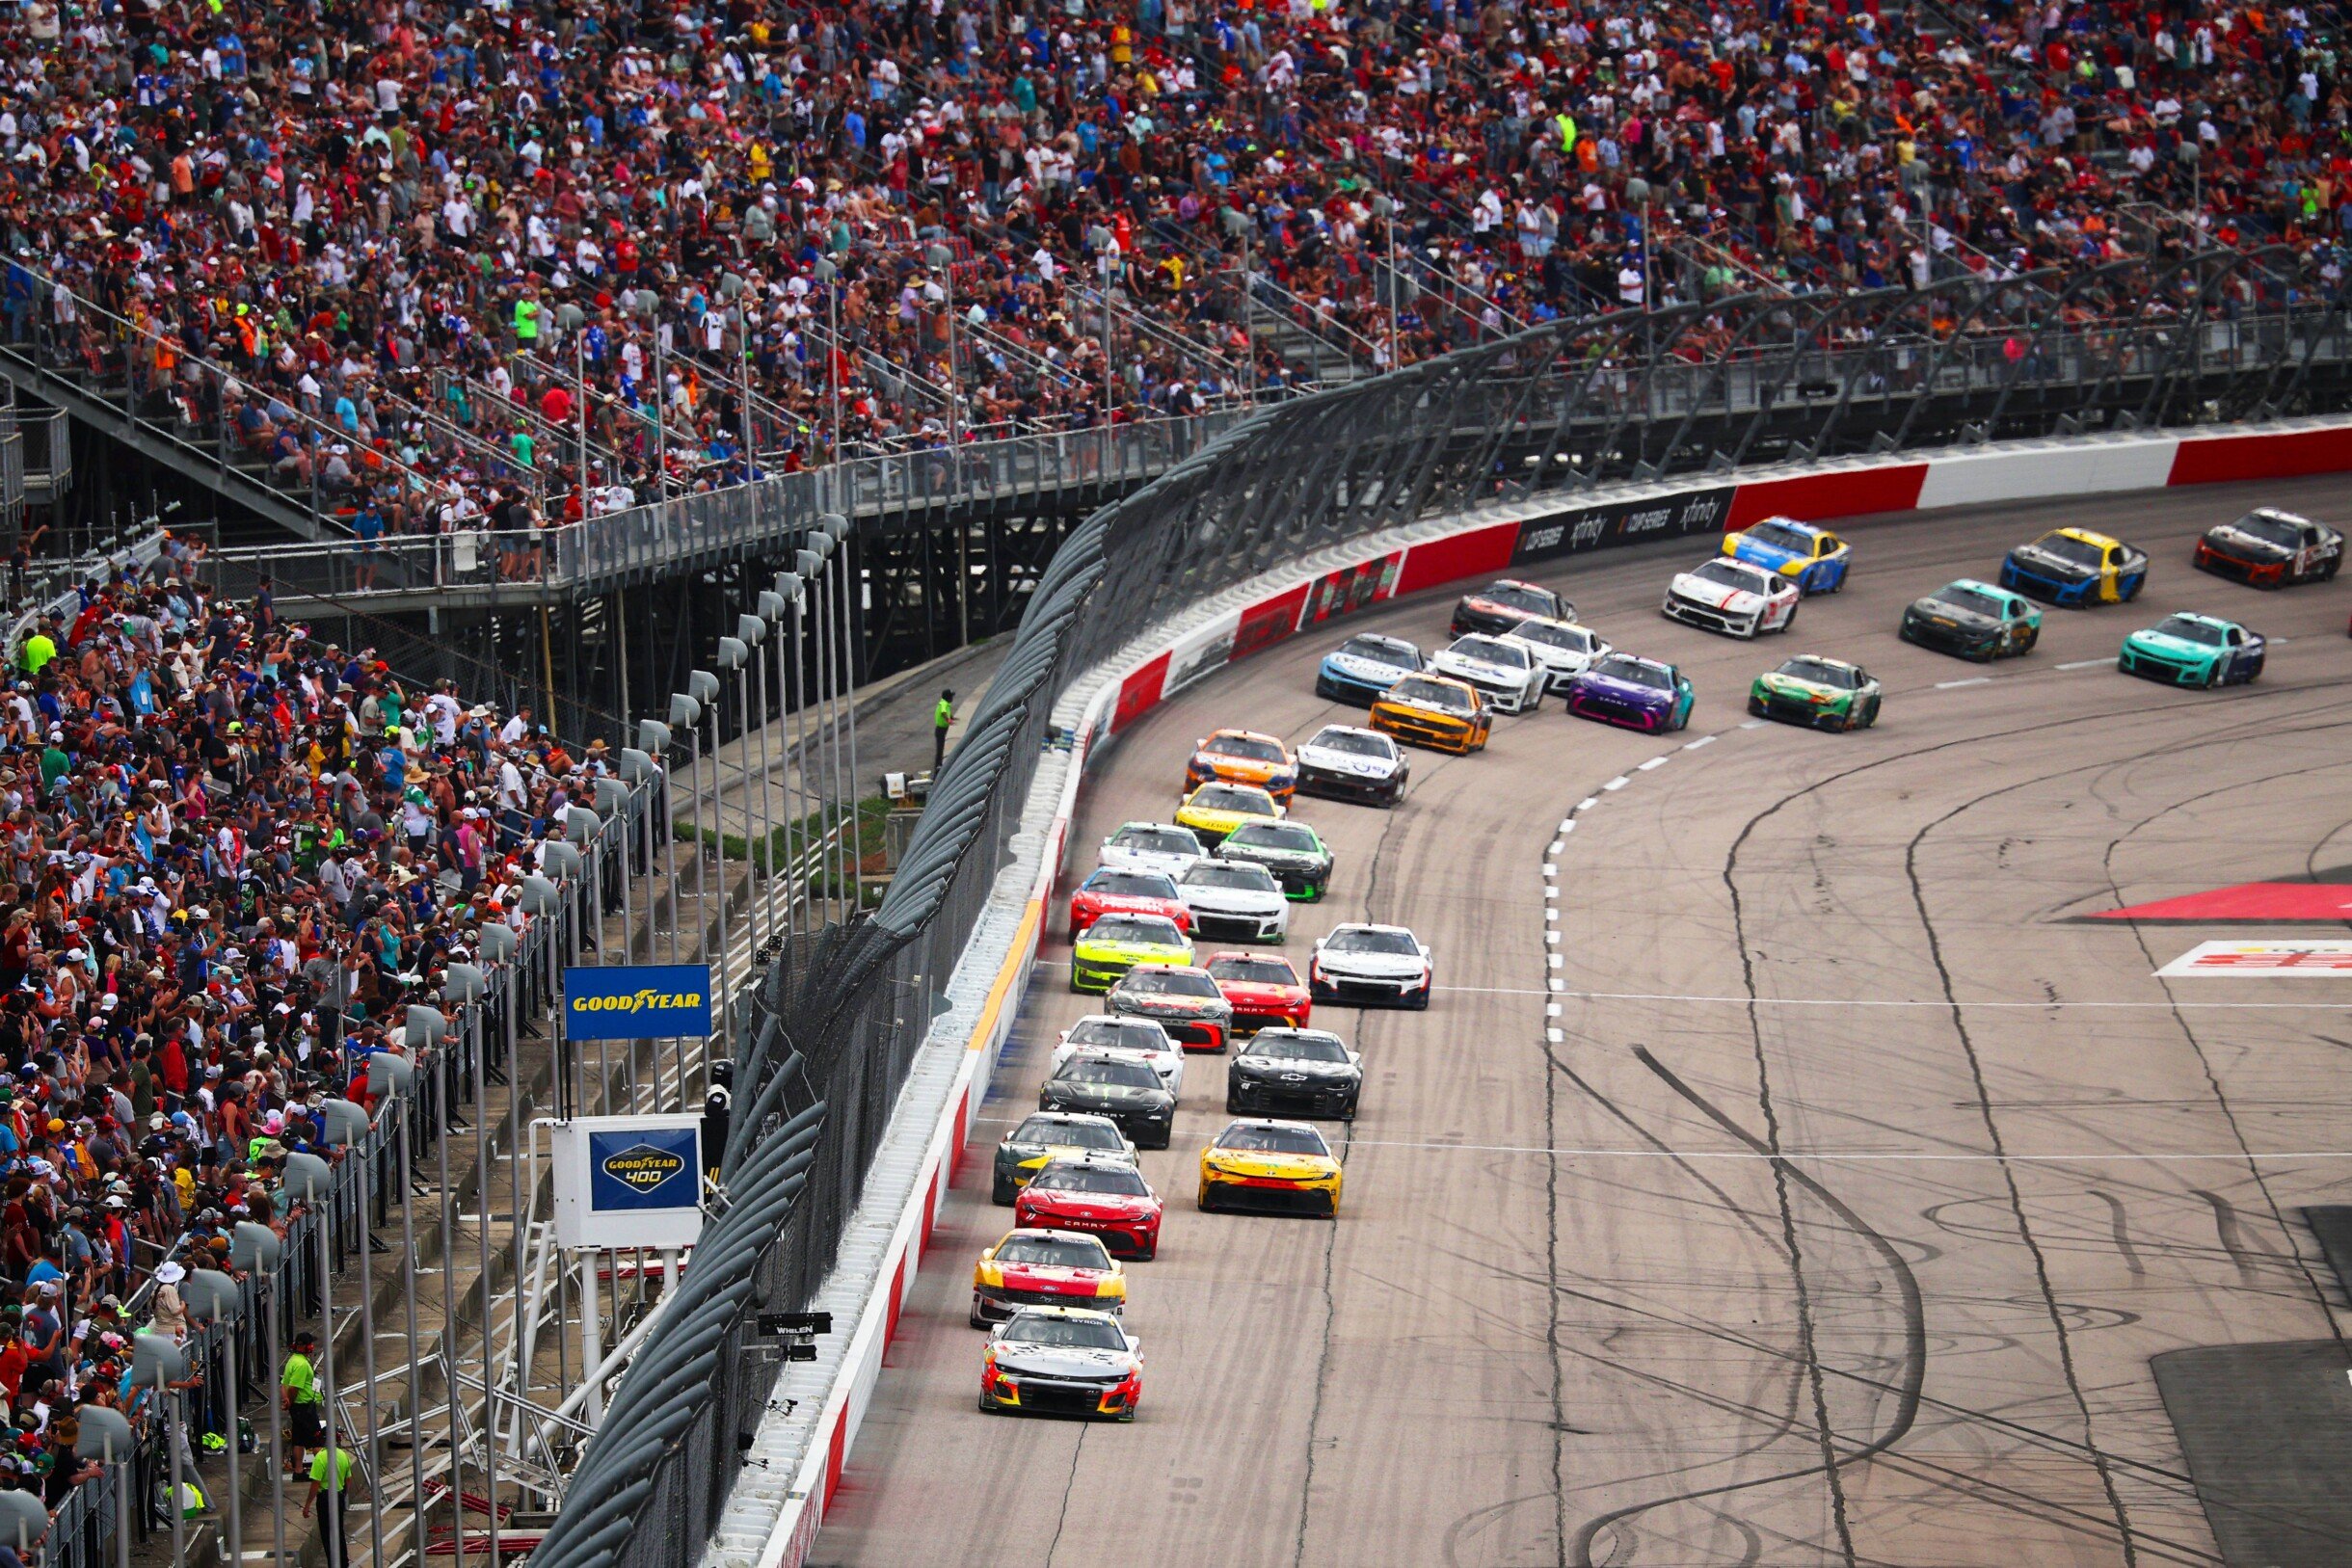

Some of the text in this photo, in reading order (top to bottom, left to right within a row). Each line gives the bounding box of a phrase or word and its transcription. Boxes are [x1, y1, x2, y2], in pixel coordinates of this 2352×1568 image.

[573, 992, 702, 1013] GOODYEAR
[608, 1158, 678, 1170] GOODYEAR
[626, 1171, 662, 1183] 400
[1064, 1220, 1108, 1229] CAMRY
[1072, 1317, 1104, 1326] BYRON
[776, 1325, 814, 1335] WHELEN
